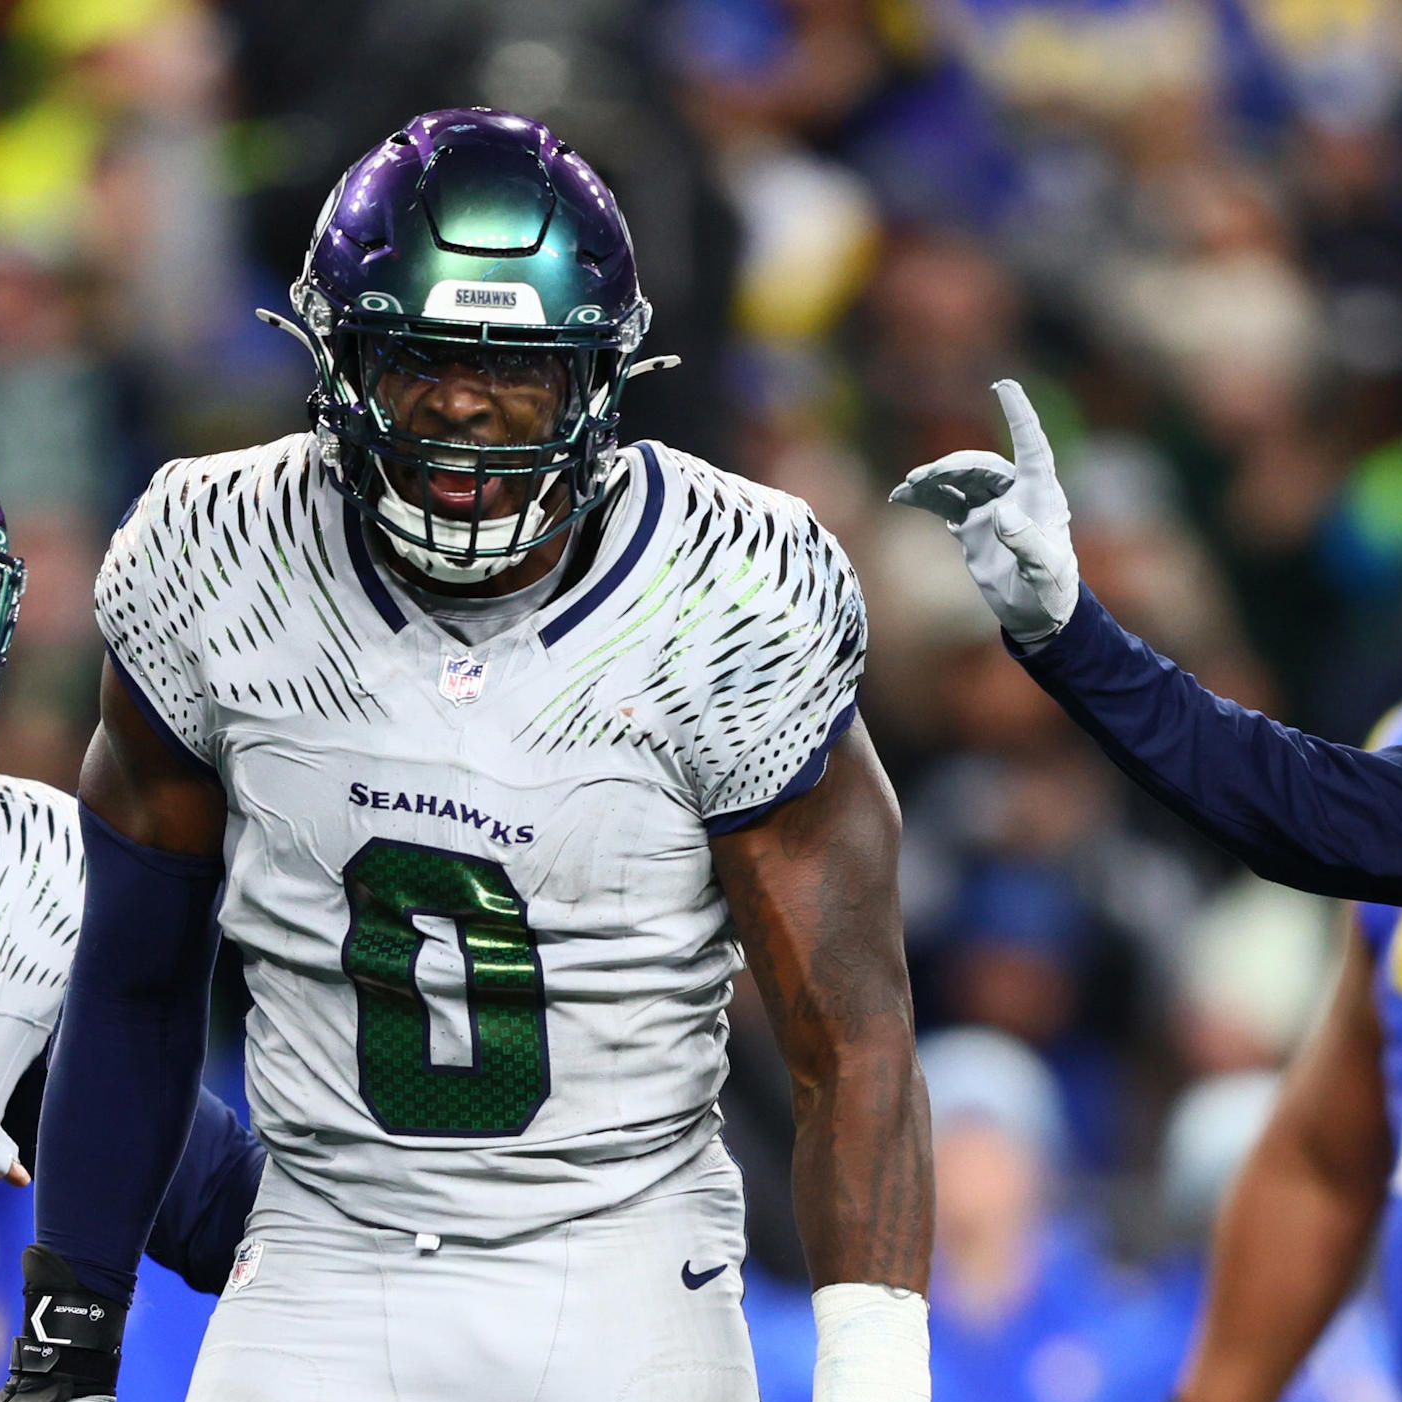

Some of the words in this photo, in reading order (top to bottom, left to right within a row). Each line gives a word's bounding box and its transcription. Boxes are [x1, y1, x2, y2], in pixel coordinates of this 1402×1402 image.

[456, 289, 517, 306] SEAHAWKS
[448, 674, 476, 696] NFL
[349, 782, 534, 844] SEAHAWKS
[343, 836, 551, 1136] 0
